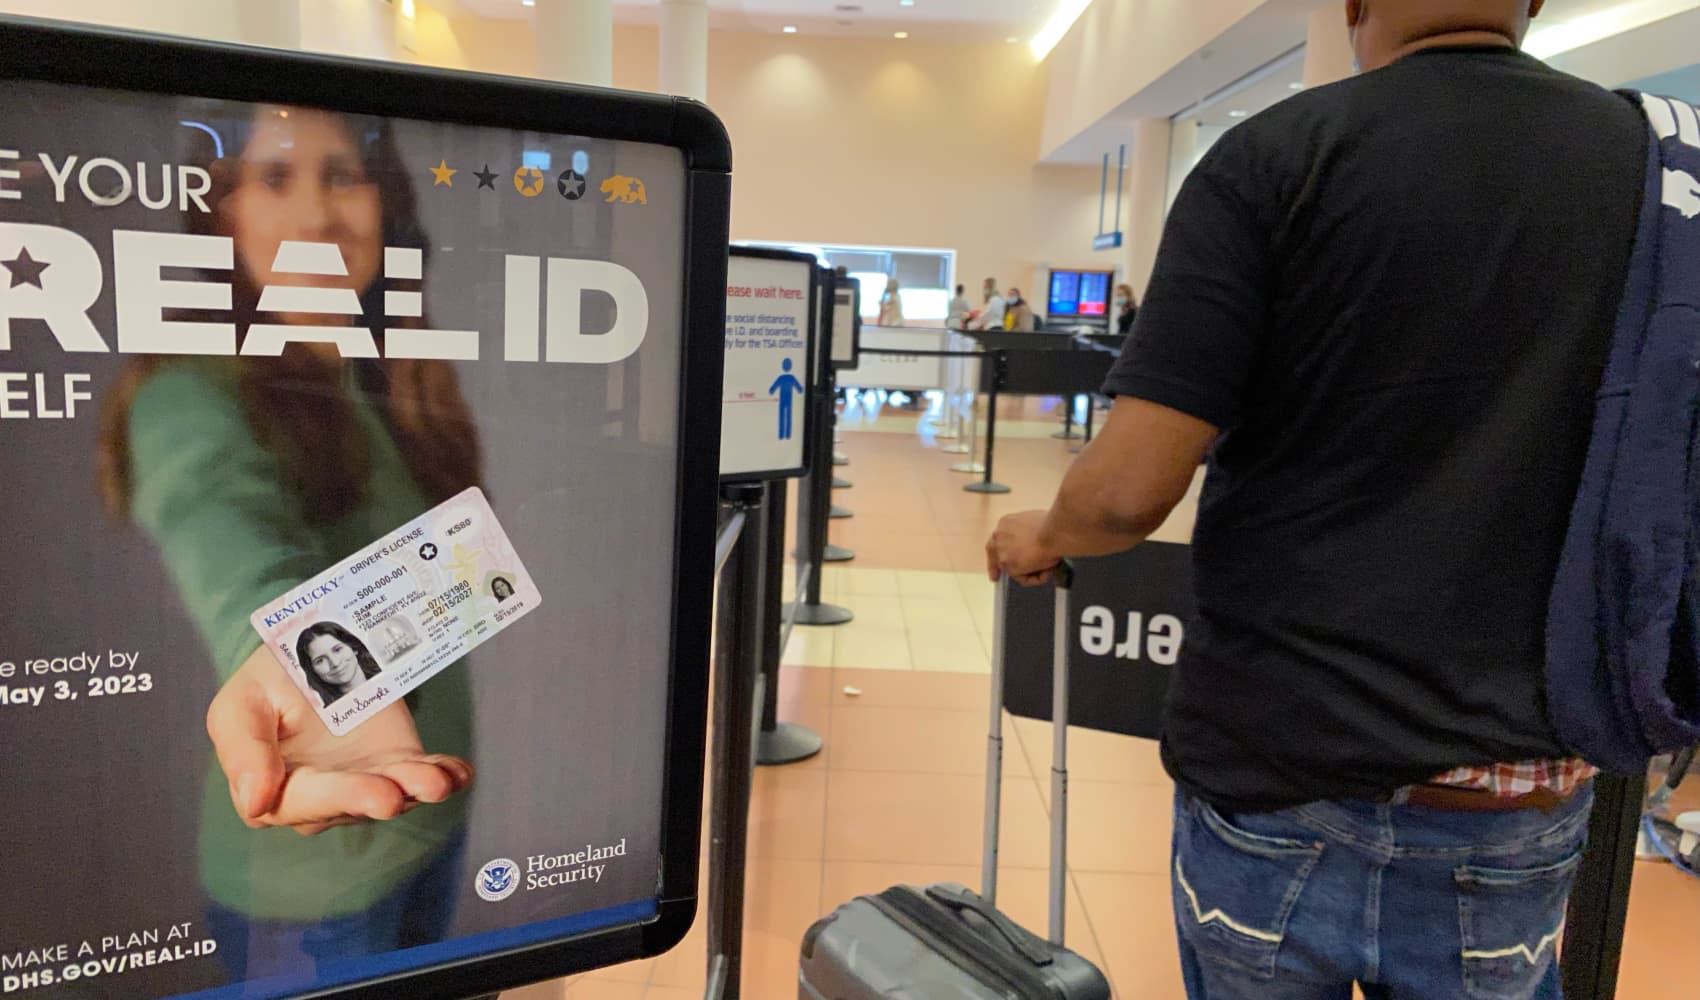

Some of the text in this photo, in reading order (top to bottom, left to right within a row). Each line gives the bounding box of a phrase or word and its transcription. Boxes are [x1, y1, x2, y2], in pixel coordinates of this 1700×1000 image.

[38, 152, 212, 213] YOUR
[0, 221, 649, 364] REAL ID
[754, 286, 776, 298] wait
[734, 314, 755, 323] social
[758, 314, 796, 326] distancing
[749, 327, 763, 336] and
[765, 327, 799, 338] boarding
[735, 339, 746, 348] for
[748, 339, 761, 348] the
[763, 339, 776, 349] TSA
[264, 527, 425, 628] KENTUCKY DRIVER'S LICENSE
[356, 565, 408, 600] S00-000-001
[354, 594, 388, 618] SAMPLE
[428, 579, 470, 610] 07/15/1980
[432, 587, 473, 617] 02/15/2027
[25, 651, 101, 676] ready
[108, 648, 140, 671] by
[54, 680, 78, 701] 3,
[87, 673, 153, 697] 2023
[526, 838, 627, 873] Homeland
[526, 864, 606, 891] Security
[1, 922, 192, 971] MAKE A PLAN AT
[3, 939, 217, 993] DHS.GOV/REAL-ID
